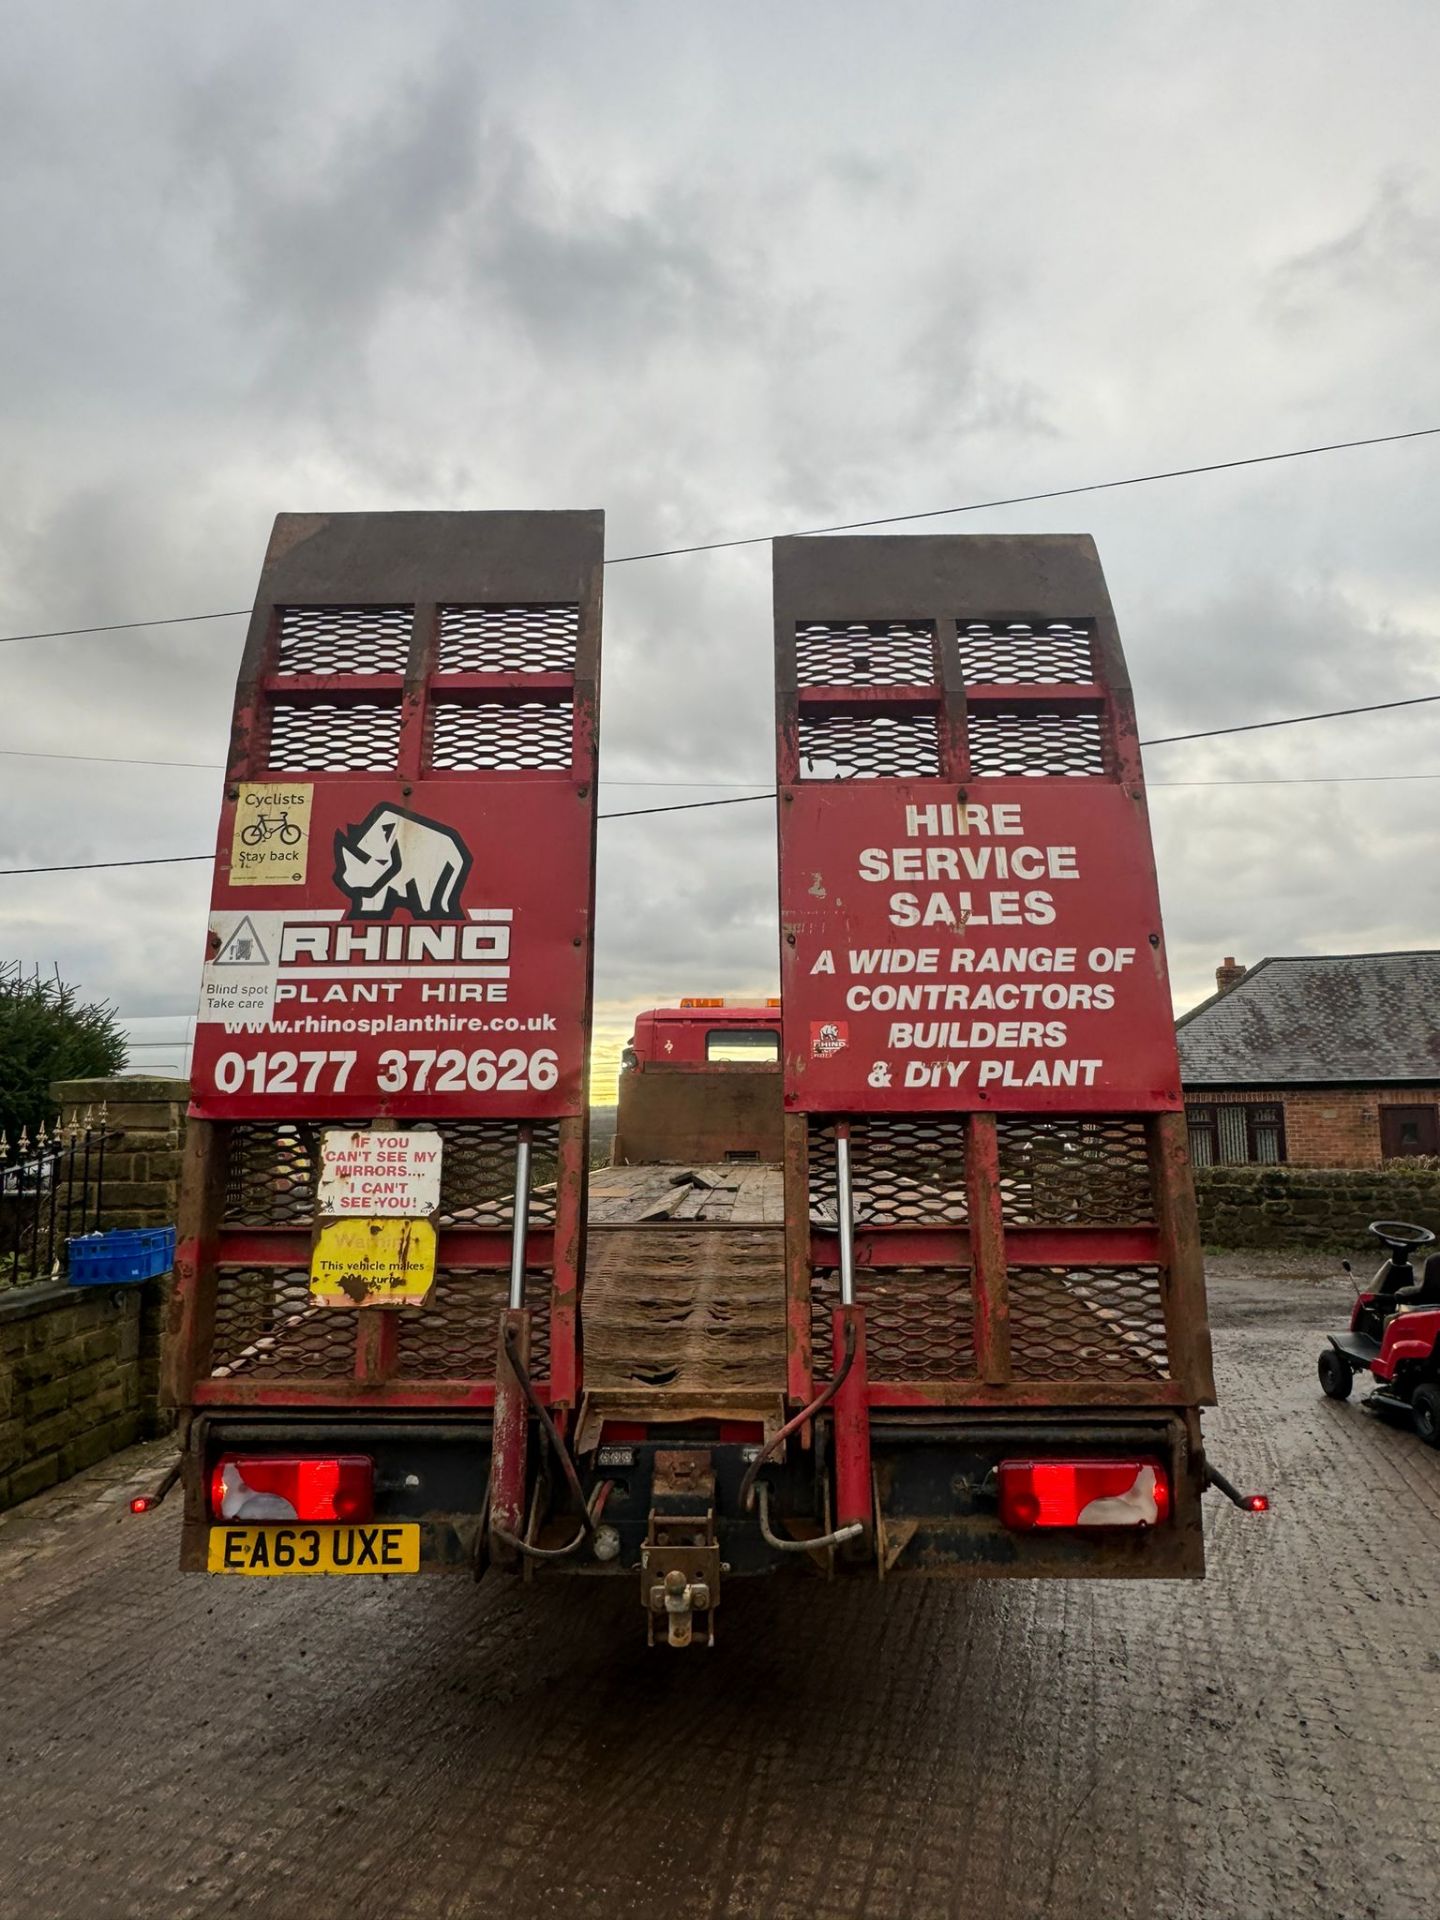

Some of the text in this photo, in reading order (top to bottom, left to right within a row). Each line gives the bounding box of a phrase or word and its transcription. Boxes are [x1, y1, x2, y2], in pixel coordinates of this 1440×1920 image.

[245, 793, 305, 808] Cyclists
[905, 803, 1024, 837] HIRE
[239, 851, 299, 864] Stay back
[858, 846, 1080, 882] SERVICE
[888, 890, 1057, 927] SALES
[279, 925, 511, 963] RHINO
[810, 947, 1136, 975] A WIDE RANGE OF
[206, 984, 269, 996] Blind spot
[275, 983, 508, 1003] PLANT HIRE
[846, 984, 1115, 1012] CONTRACTORS
[208, 998, 264, 1008] Take care
[224, 1014, 556, 1036] www.rhinosplanthire.co.uk
[887, 1021, 1068, 1049] BUILDERS
[214, 1048, 559, 1094] 01277 372626
[867, 1059, 1103, 1088] & DIY PLANT
[355, 1138, 409, 1149] IF YOU
[325, 1151, 437, 1162] CAN'T SEE MY
[350, 1182, 408, 1194] I CAN'T
[340, 1197, 371, 1208] SEE
[320, 1261, 424, 1271] This vehicle makes
[224, 1529, 403, 1568] EA63 UXE
